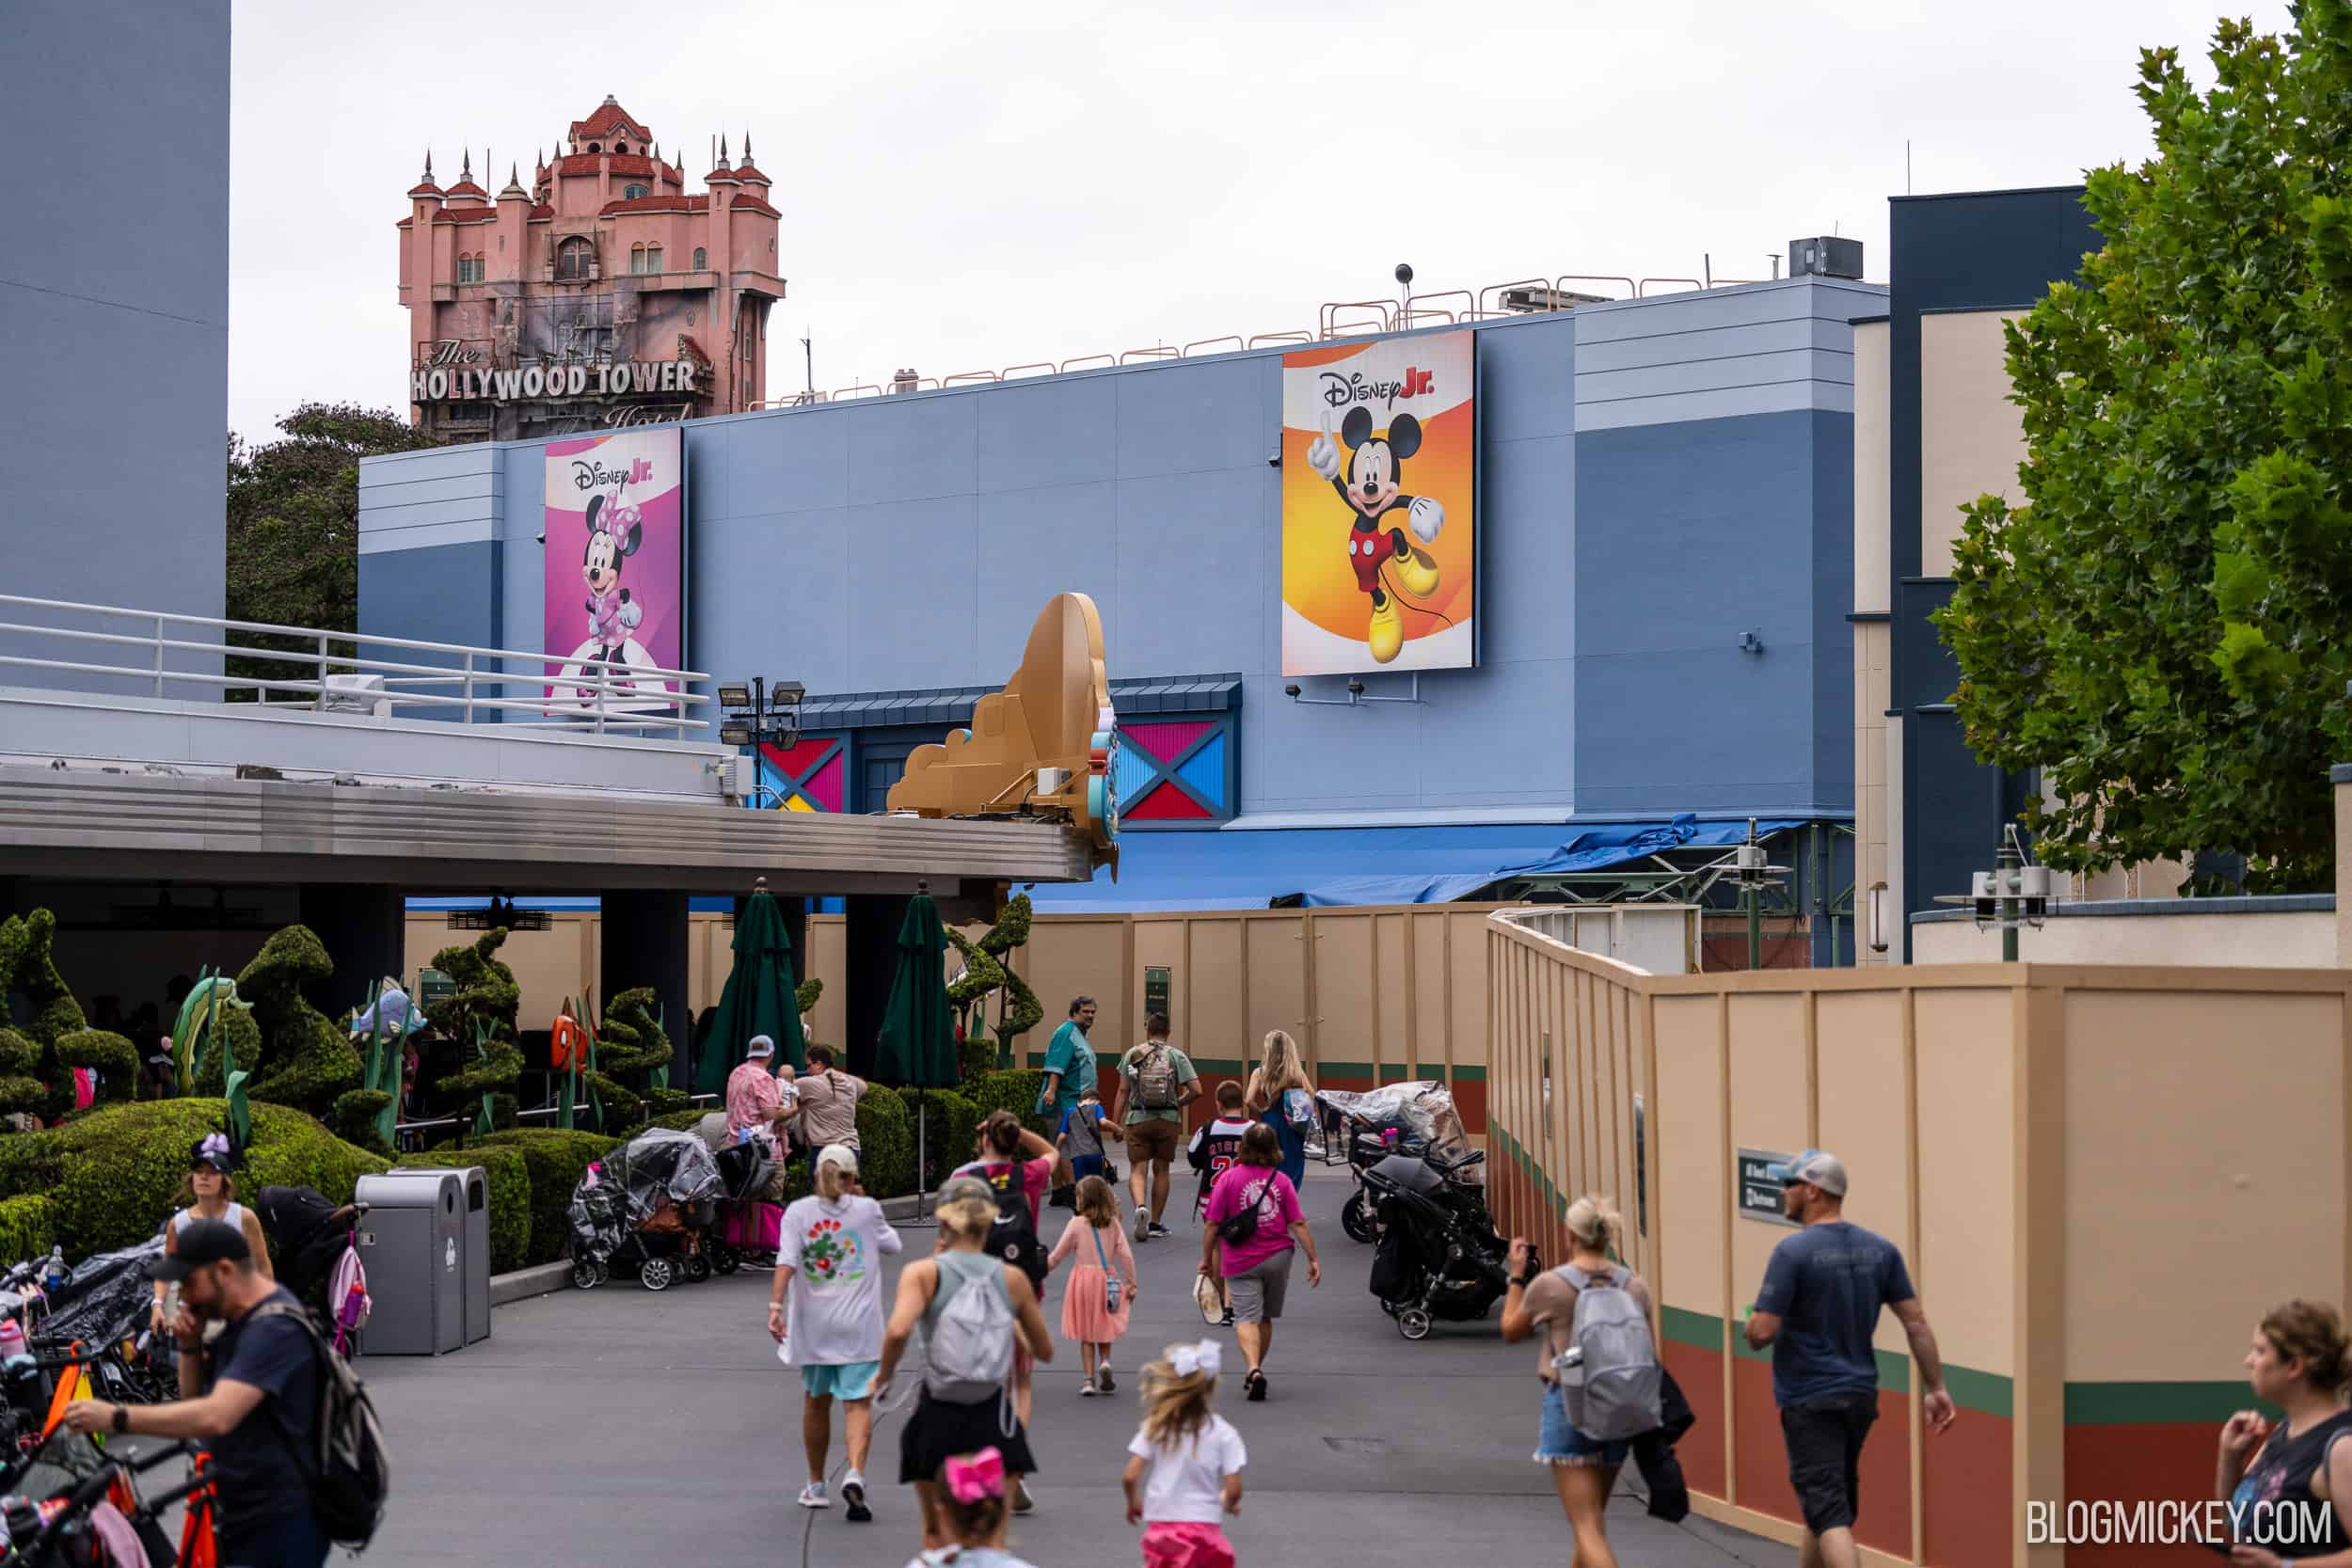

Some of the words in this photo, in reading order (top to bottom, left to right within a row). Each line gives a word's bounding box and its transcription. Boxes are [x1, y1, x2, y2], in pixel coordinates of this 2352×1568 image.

[425, 340, 479, 366] The
[410, 365, 586, 400] HOLLYWOOD
[598, 361, 694, 393] TOWER
[1399, 367, 1435, 399] Jr.
[628, 457, 653, 484] Jr.
